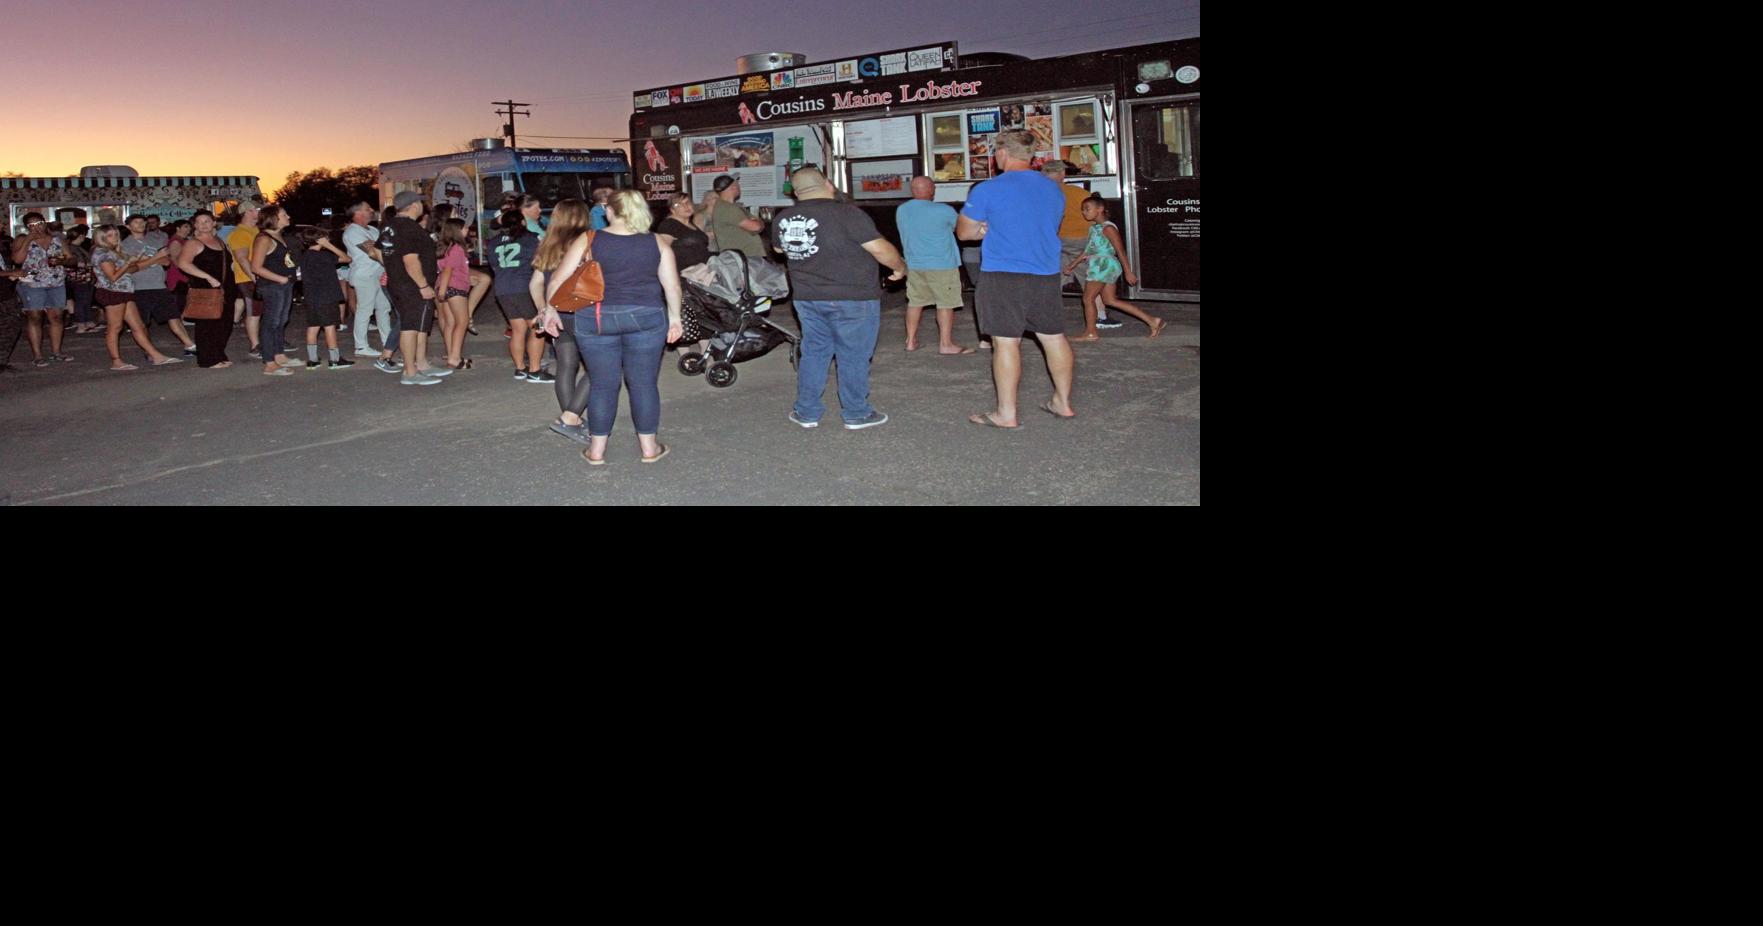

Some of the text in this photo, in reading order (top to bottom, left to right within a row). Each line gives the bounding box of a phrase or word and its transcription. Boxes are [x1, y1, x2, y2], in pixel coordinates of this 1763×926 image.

[652, 91, 668, 100] FOX
[756, 80, 982, 120] Cousins Maine Lobster
[643, 172, 676, 184] Cousins
[651, 182, 676, 192] Maine
[1166, 198, 1200, 206] Cousins
[495, 243, 520, 268] 12
